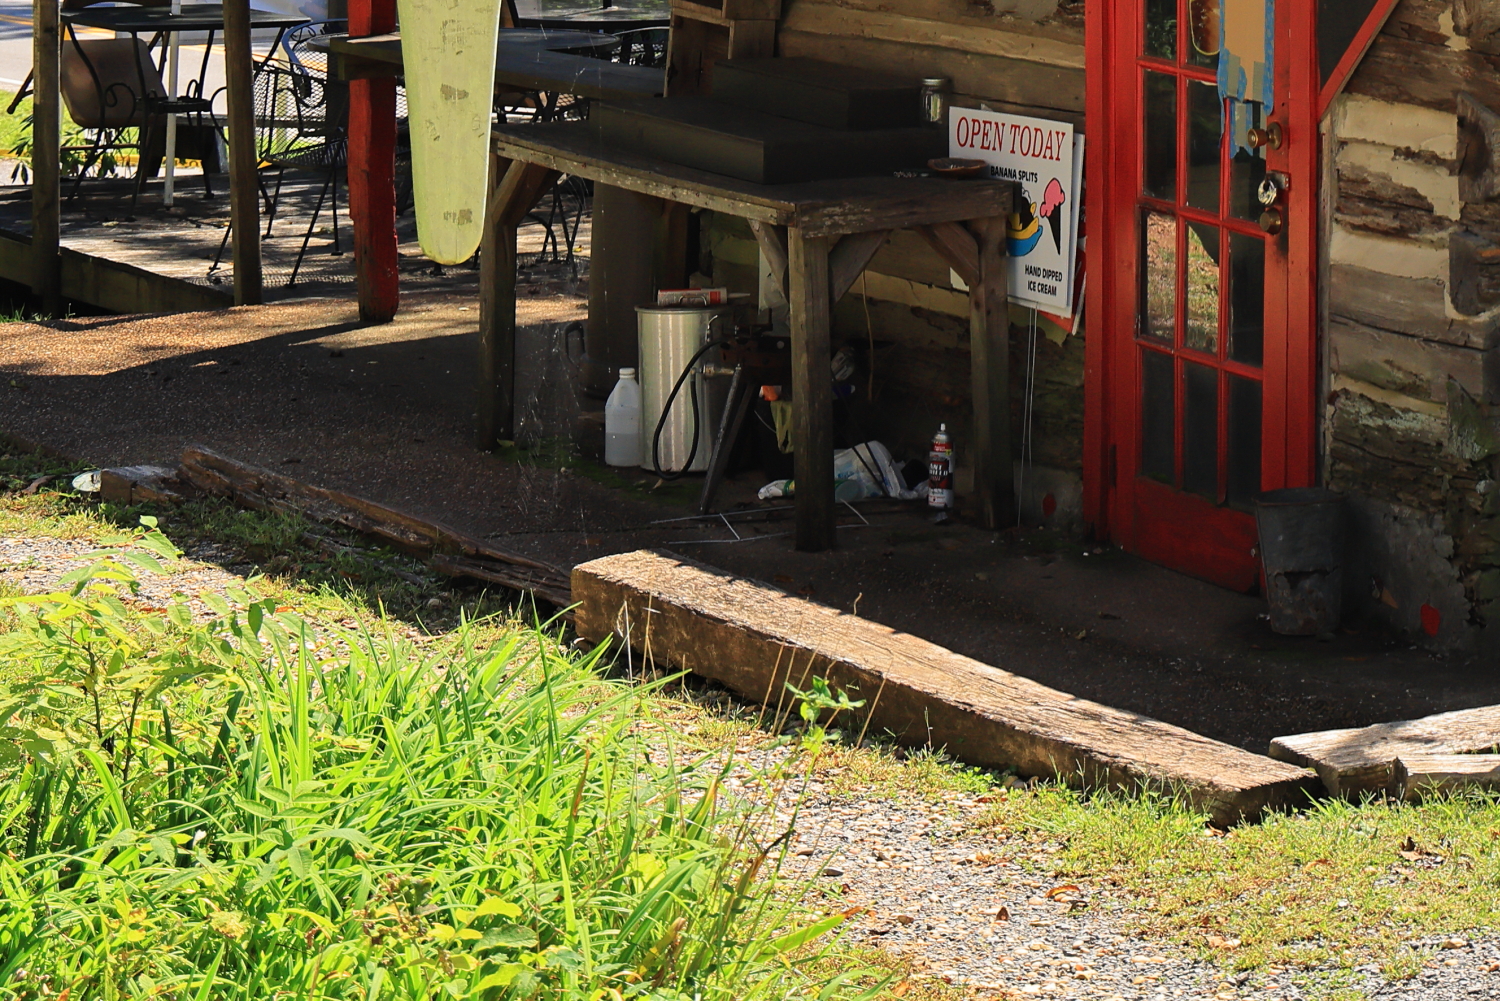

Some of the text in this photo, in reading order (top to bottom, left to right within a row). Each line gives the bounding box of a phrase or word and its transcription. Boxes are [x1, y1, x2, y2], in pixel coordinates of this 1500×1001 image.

[956, 116, 1067, 162] OPEN TODAY
[990, 165, 1039, 183] BANANA SPLITS
[1024, 263, 1063, 282] HAND DIPPED
[1027, 280, 1058, 297] ICE CREAM
